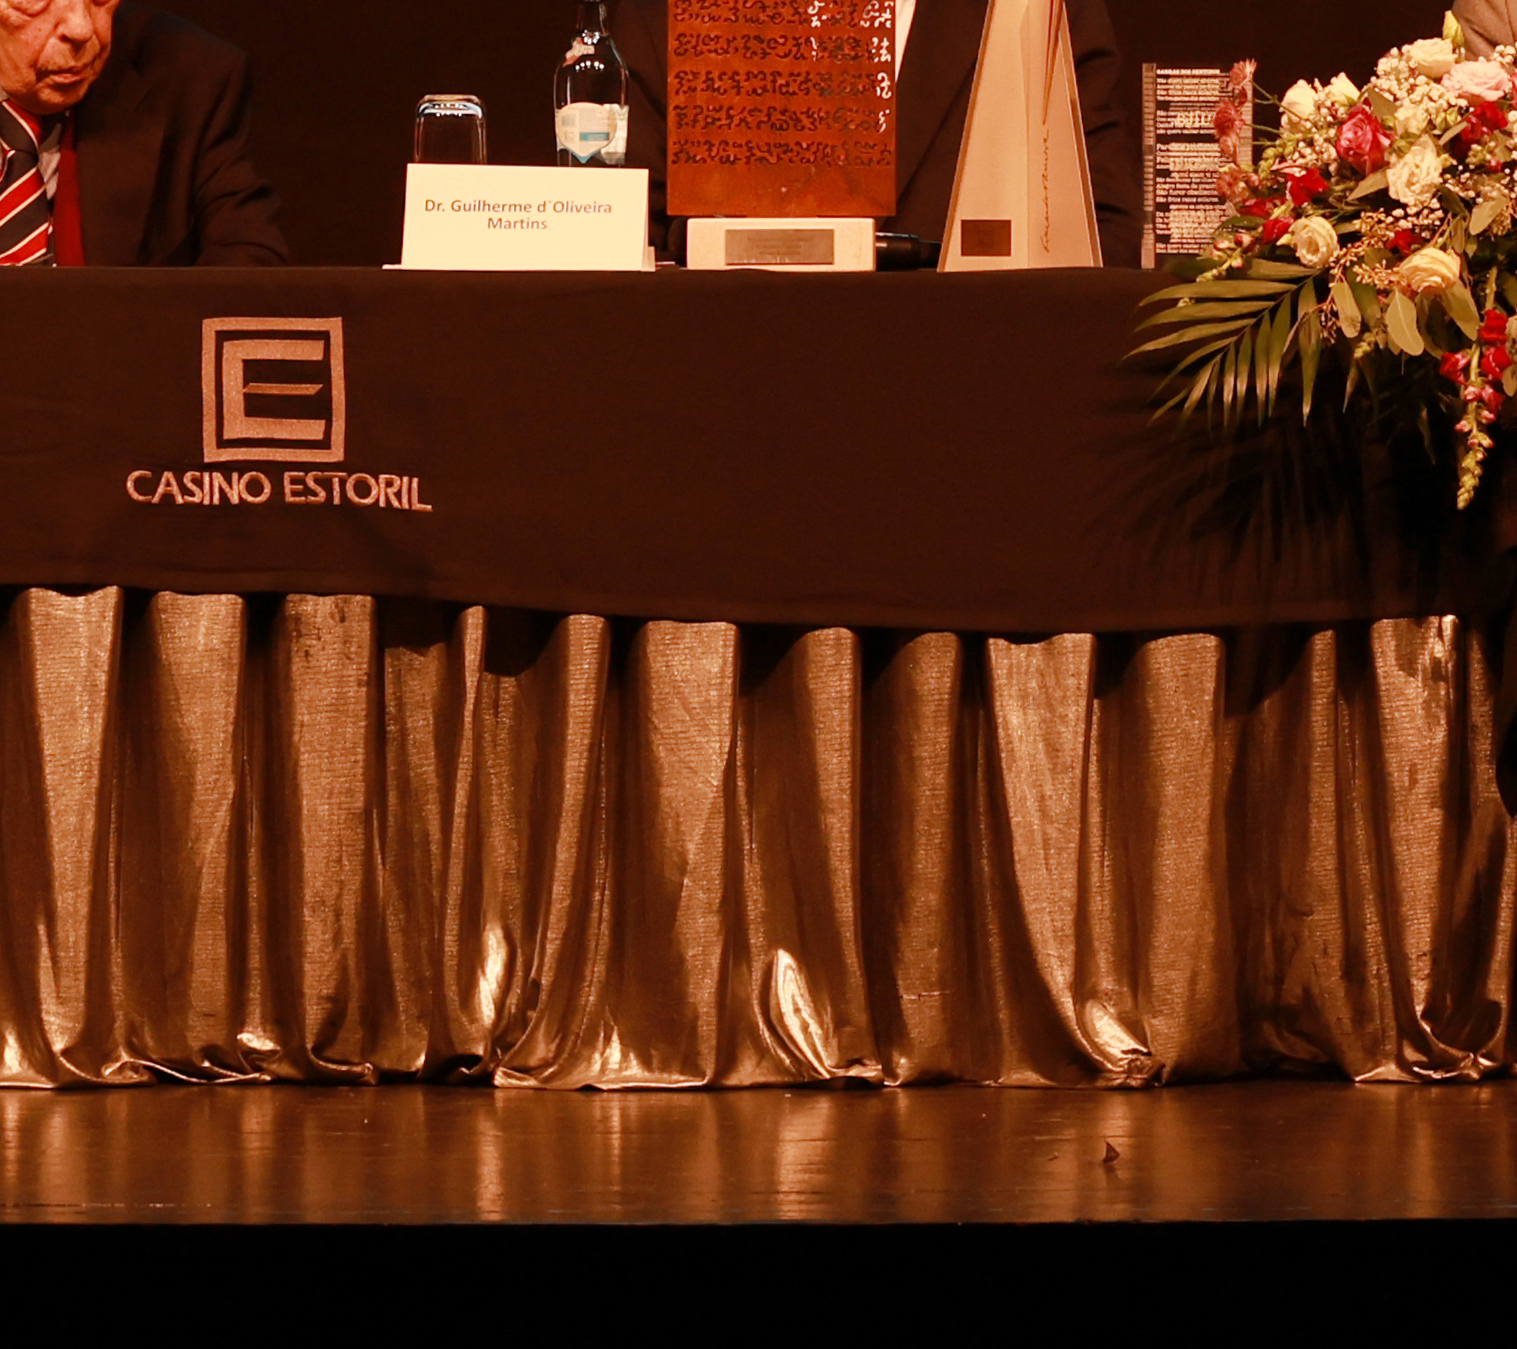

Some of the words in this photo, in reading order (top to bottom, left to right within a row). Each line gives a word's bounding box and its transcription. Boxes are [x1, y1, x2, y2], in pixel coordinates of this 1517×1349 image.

[424, 199, 445, 212] Dr.
[451, 199, 532, 213] Guilherme
[487, 217, 548, 230] Martins
[126, 470, 272, 505] CASINO
[283, 471, 433, 512] ESTORIL
